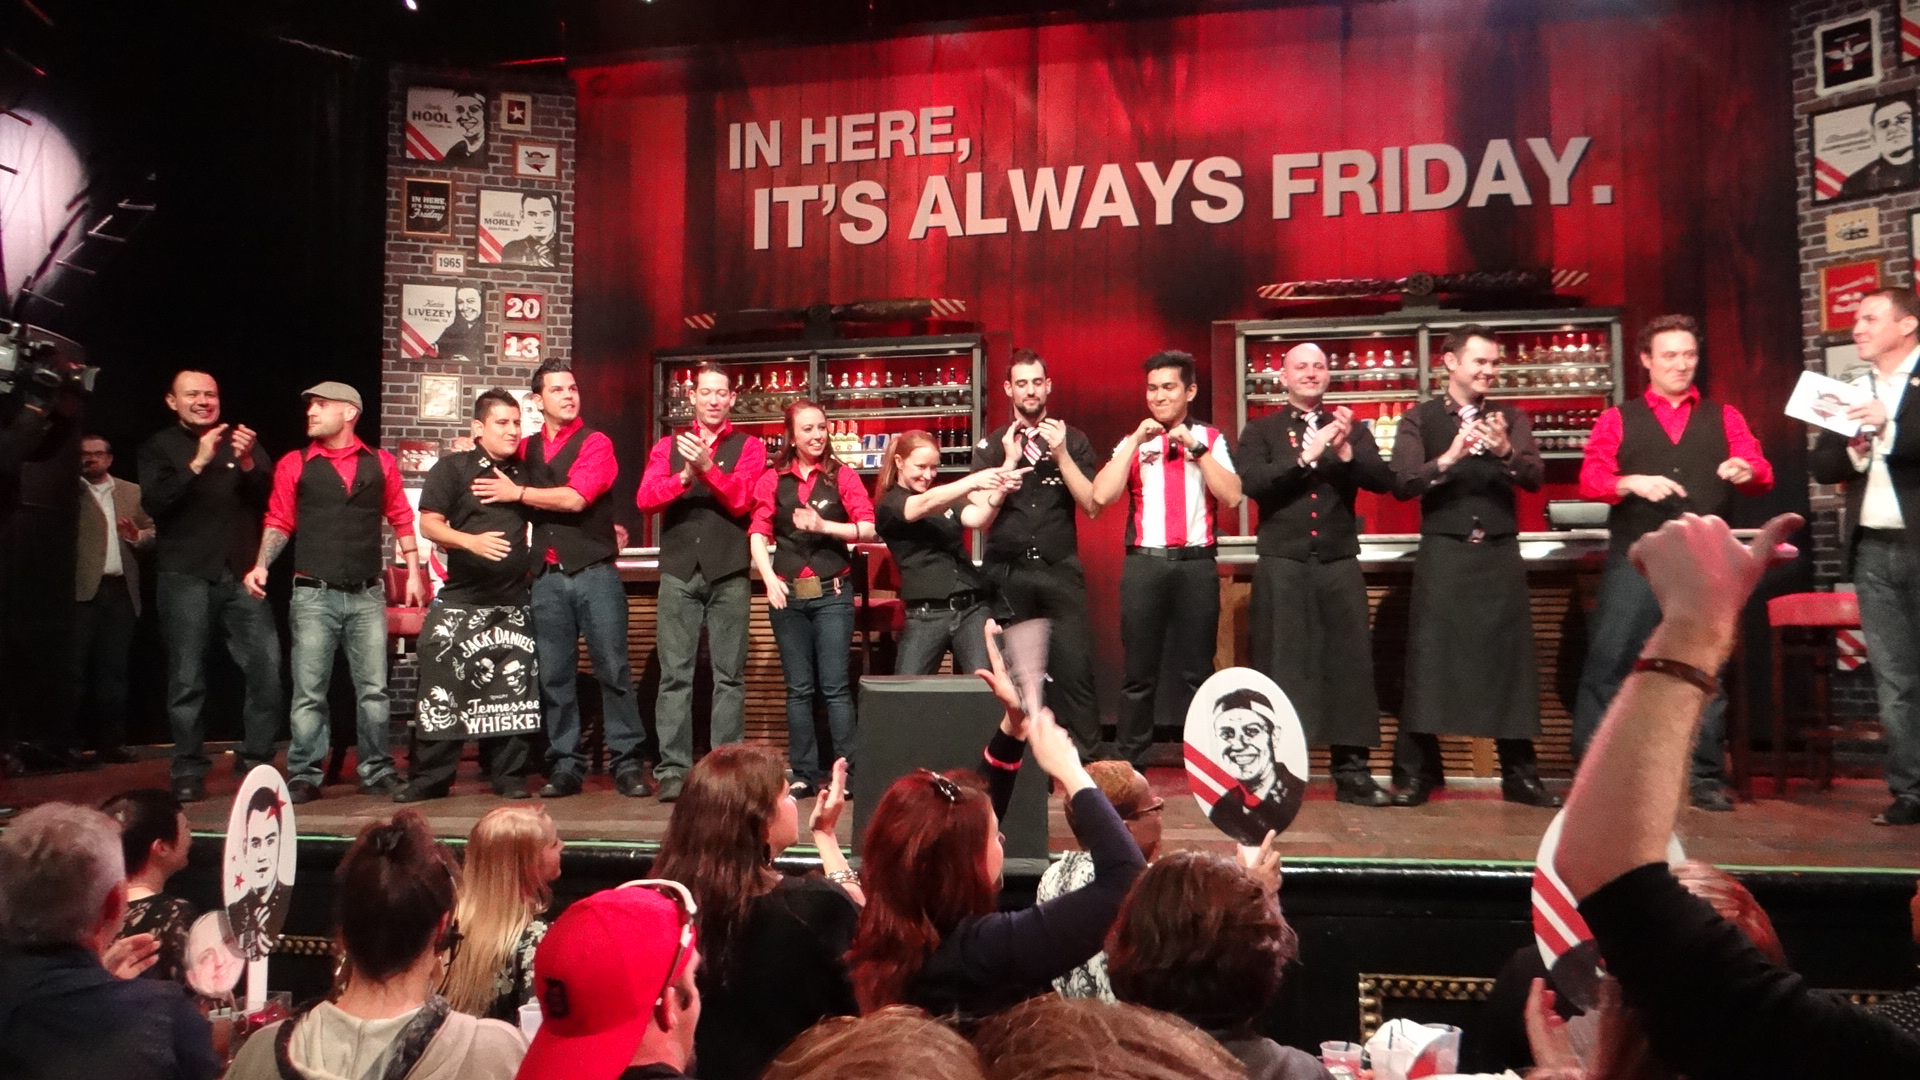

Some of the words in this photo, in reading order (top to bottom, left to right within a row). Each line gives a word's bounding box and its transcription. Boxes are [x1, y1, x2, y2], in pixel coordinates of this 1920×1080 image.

[412, 110, 452, 124] HOOL
[729, 120, 781, 169] IN
[801, 105, 970, 165] HERE,
[753, 180, 888, 250] IT'S
[908, 155, 1246, 240] ALWAYS
[1272, 136, 1613, 220] FRIDAY.
[484, 217, 521, 227] MORLEY
[439, 257, 461, 268] 1965
[408, 308, 452, 318] LIVEZEY
[506, 297, 540, 319] 20
[505, 336, 540, 358] 13
[460, 630, 494, 658] JACK
[494, 626, 536, 654] DANIEL'S
[467, 698, 540, 715] Tennessee
[462, 713, 541, 735] WHISKEY
